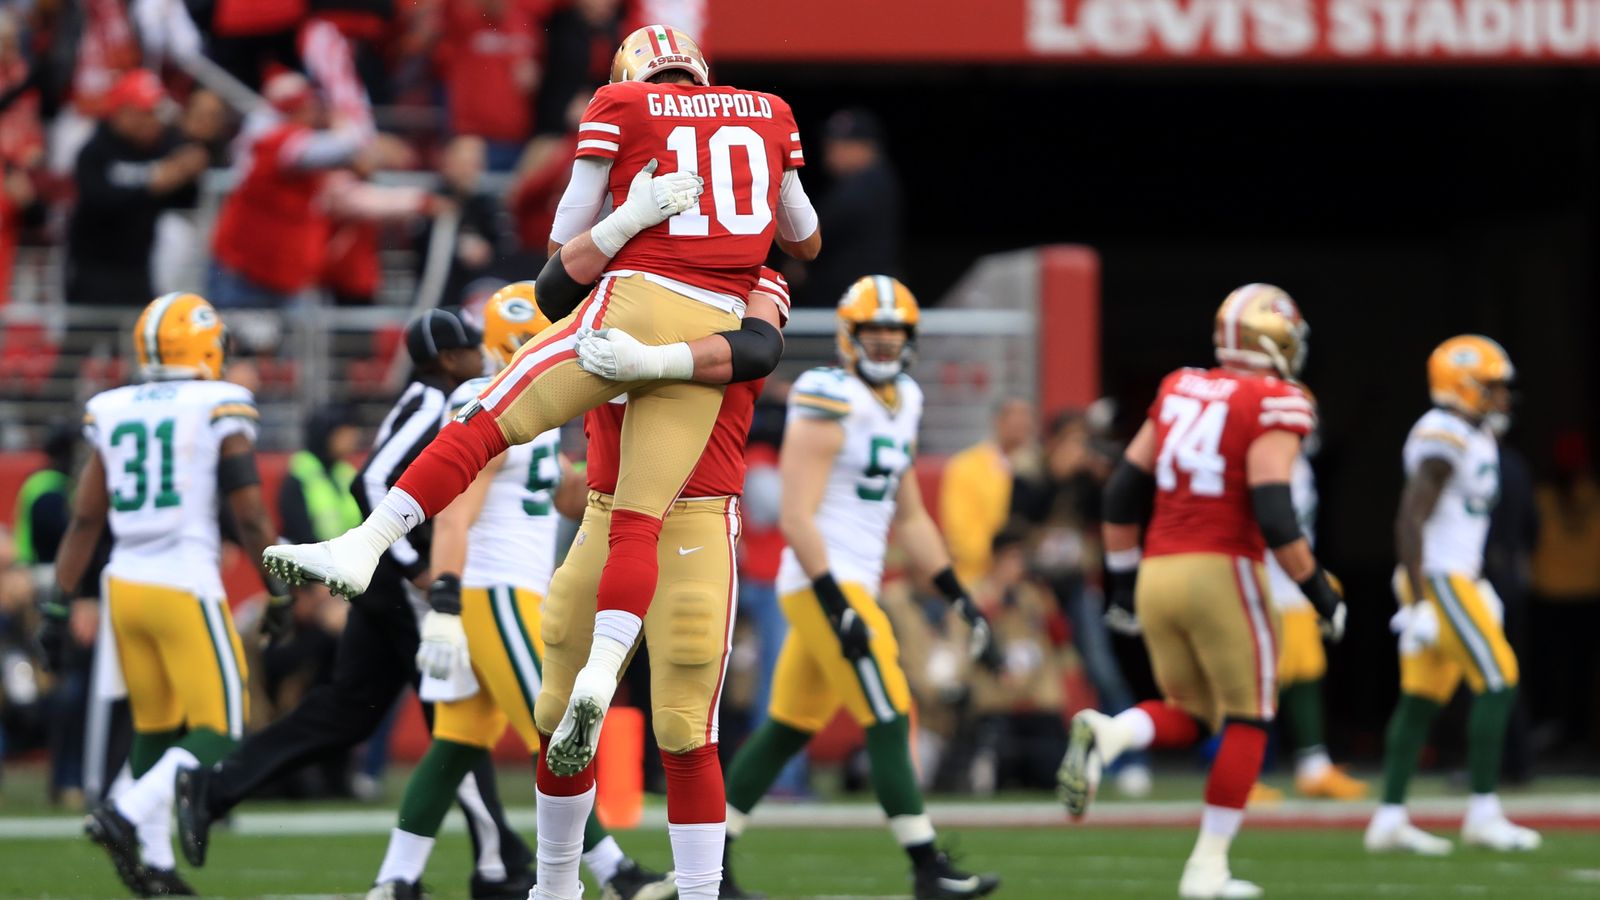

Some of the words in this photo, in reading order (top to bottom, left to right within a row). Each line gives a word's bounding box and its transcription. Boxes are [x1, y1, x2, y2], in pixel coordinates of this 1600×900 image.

[1327, 0, 1600, 55] STADIU
[647, 55, 692, 69] 49ERS
[648, 93, 773, 118] GAROPPOLO
[666, 126, 772, 236] 10
[110, 418, 181, 512] 31
[856, 437, 911, 500] 5
[1157, 395, 1228, 496] 74
